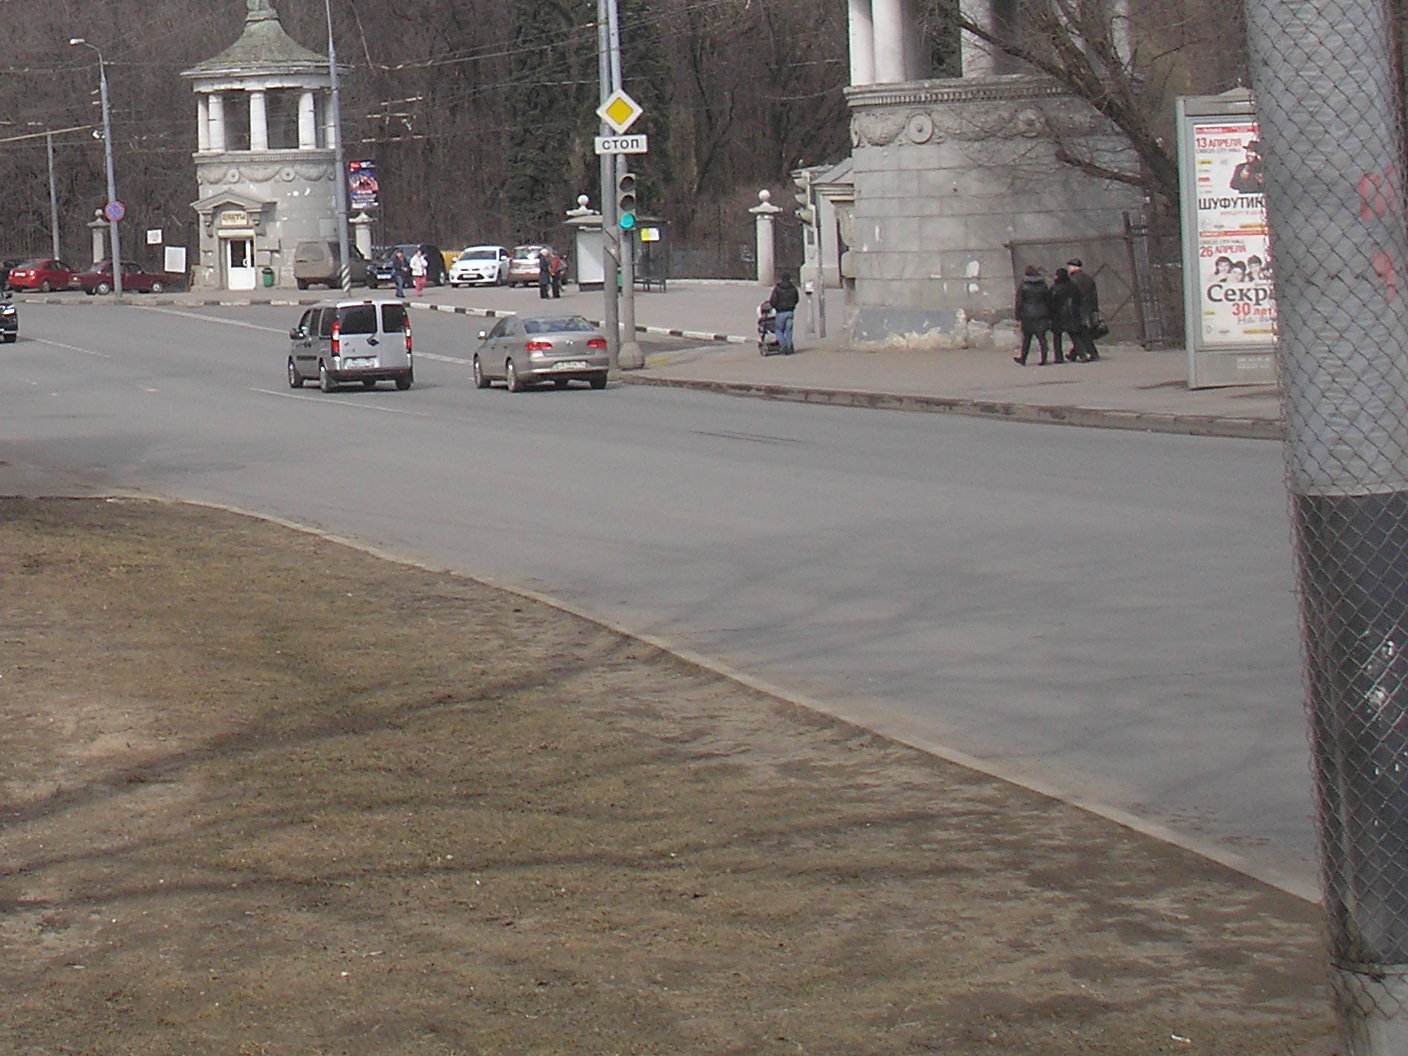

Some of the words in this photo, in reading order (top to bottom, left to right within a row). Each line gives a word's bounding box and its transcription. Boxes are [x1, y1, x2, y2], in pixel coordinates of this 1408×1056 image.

[602, 138, 640, 150] СТОП
[1196, 137, 1207, 148] 13
[1199, 246, 1213, 258] 26
[1232, 303, 1251, 316] 30
